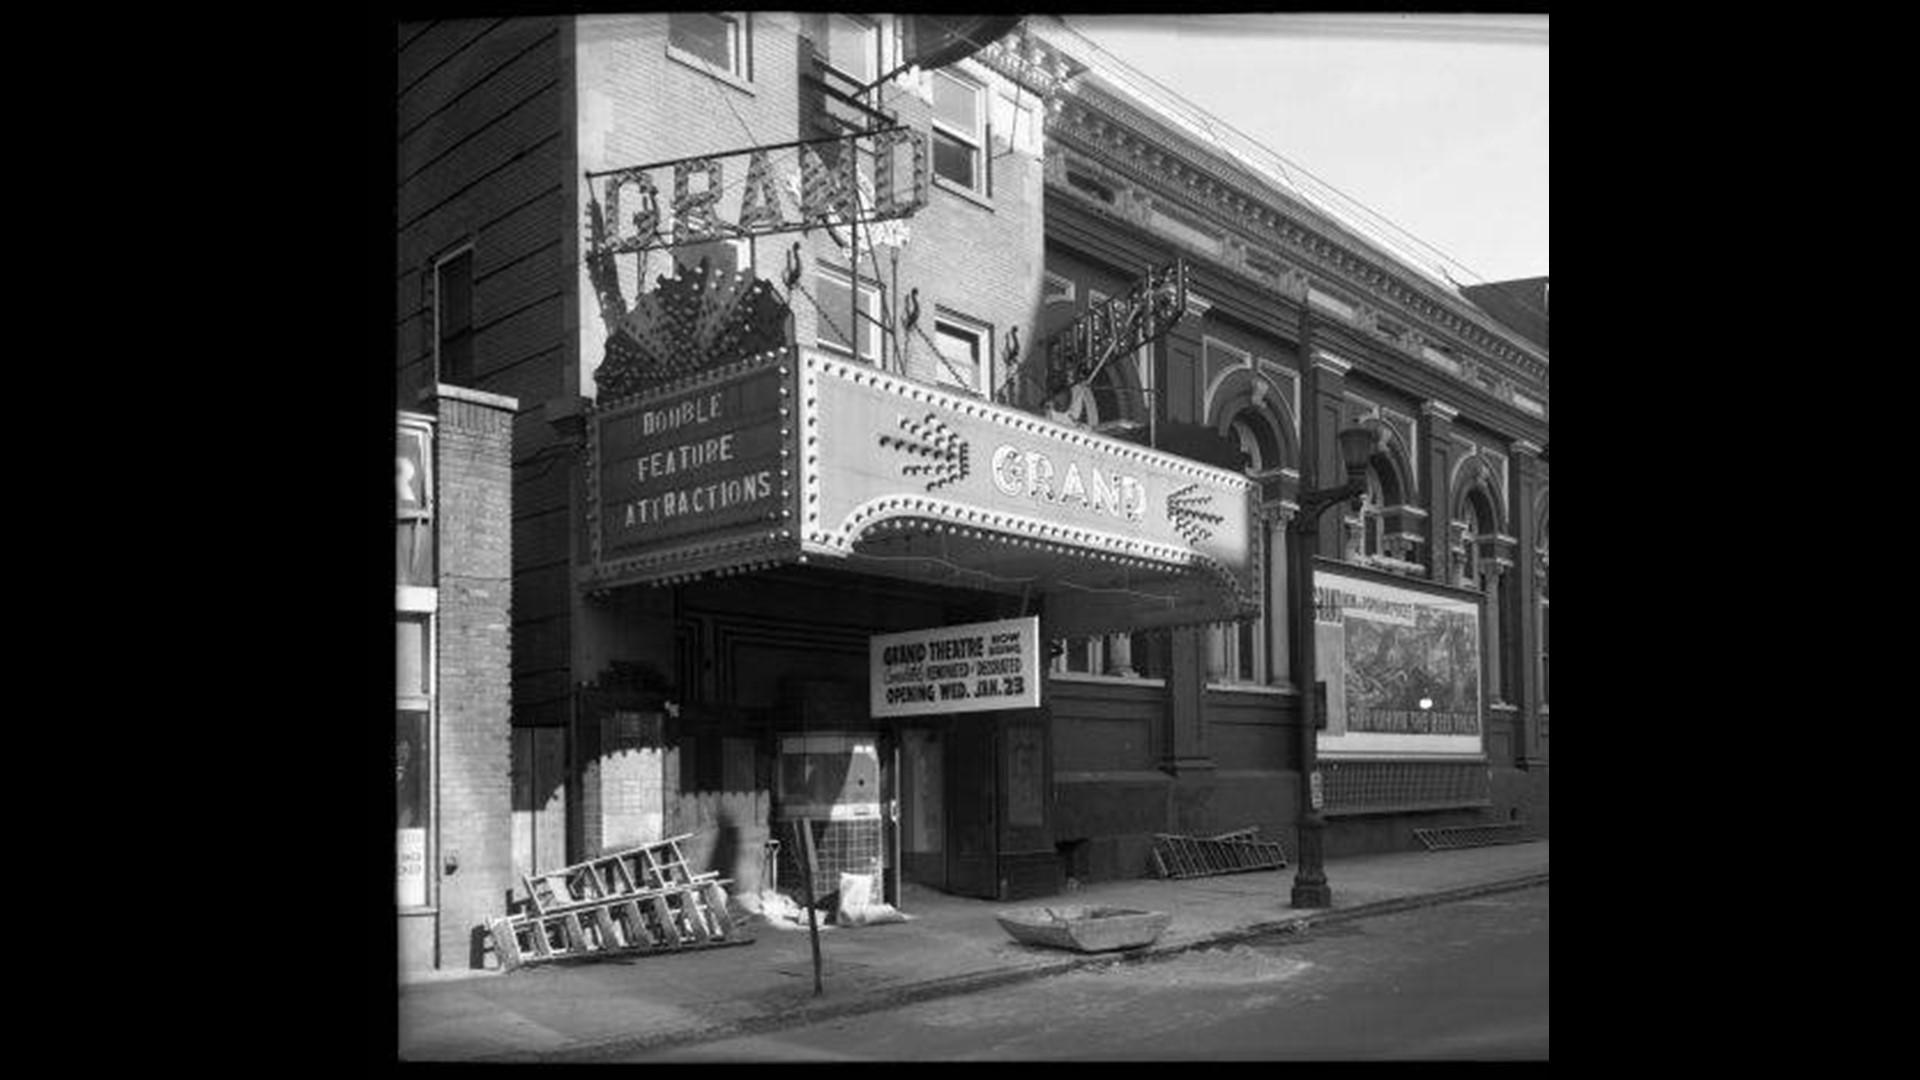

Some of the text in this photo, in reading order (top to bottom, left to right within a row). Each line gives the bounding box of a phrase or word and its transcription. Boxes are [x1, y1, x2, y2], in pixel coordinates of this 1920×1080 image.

[604, 132, 928, 252] GRAND
[643, 393, 722, 436] DOUBLE
[638, 434, 734, 482] FEATURE
[625, 472, 770, 527] ATTRACTIONS
[991, 443, 1147, 521] GRAND
[885, 637, 983, 666] GRAND THEATRE
[991, 632, 1020, 645] NOW
[886, 676, 1025, 704] OPENING WED. JAN. 23
